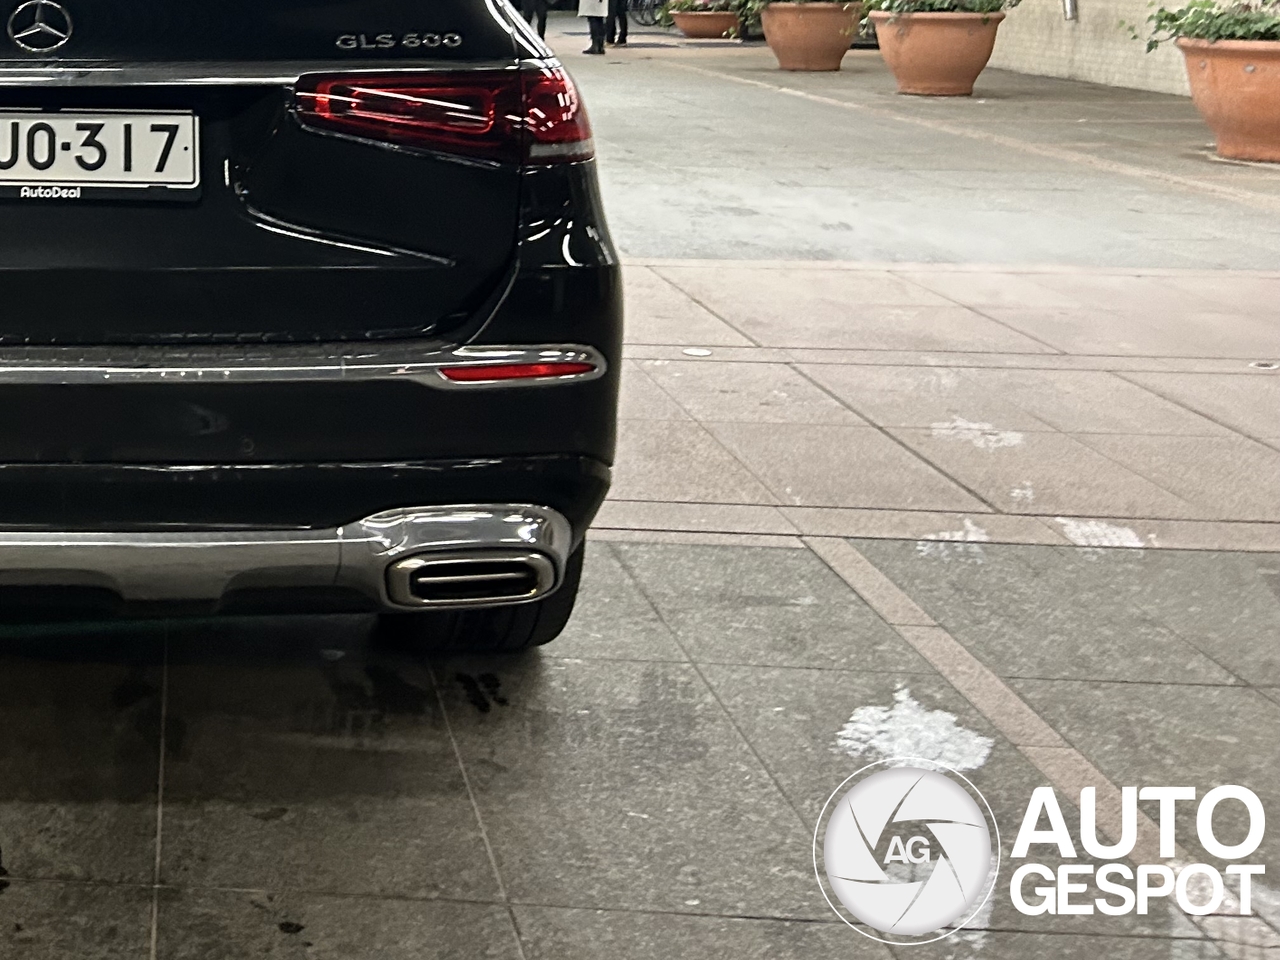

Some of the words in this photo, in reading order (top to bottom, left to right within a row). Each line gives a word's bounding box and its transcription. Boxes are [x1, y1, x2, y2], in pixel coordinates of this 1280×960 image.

[335, 34, 396, 49] GLS
[402, 33, 462, 48] 600
[20, 186, 81, 199] AutoDeal
